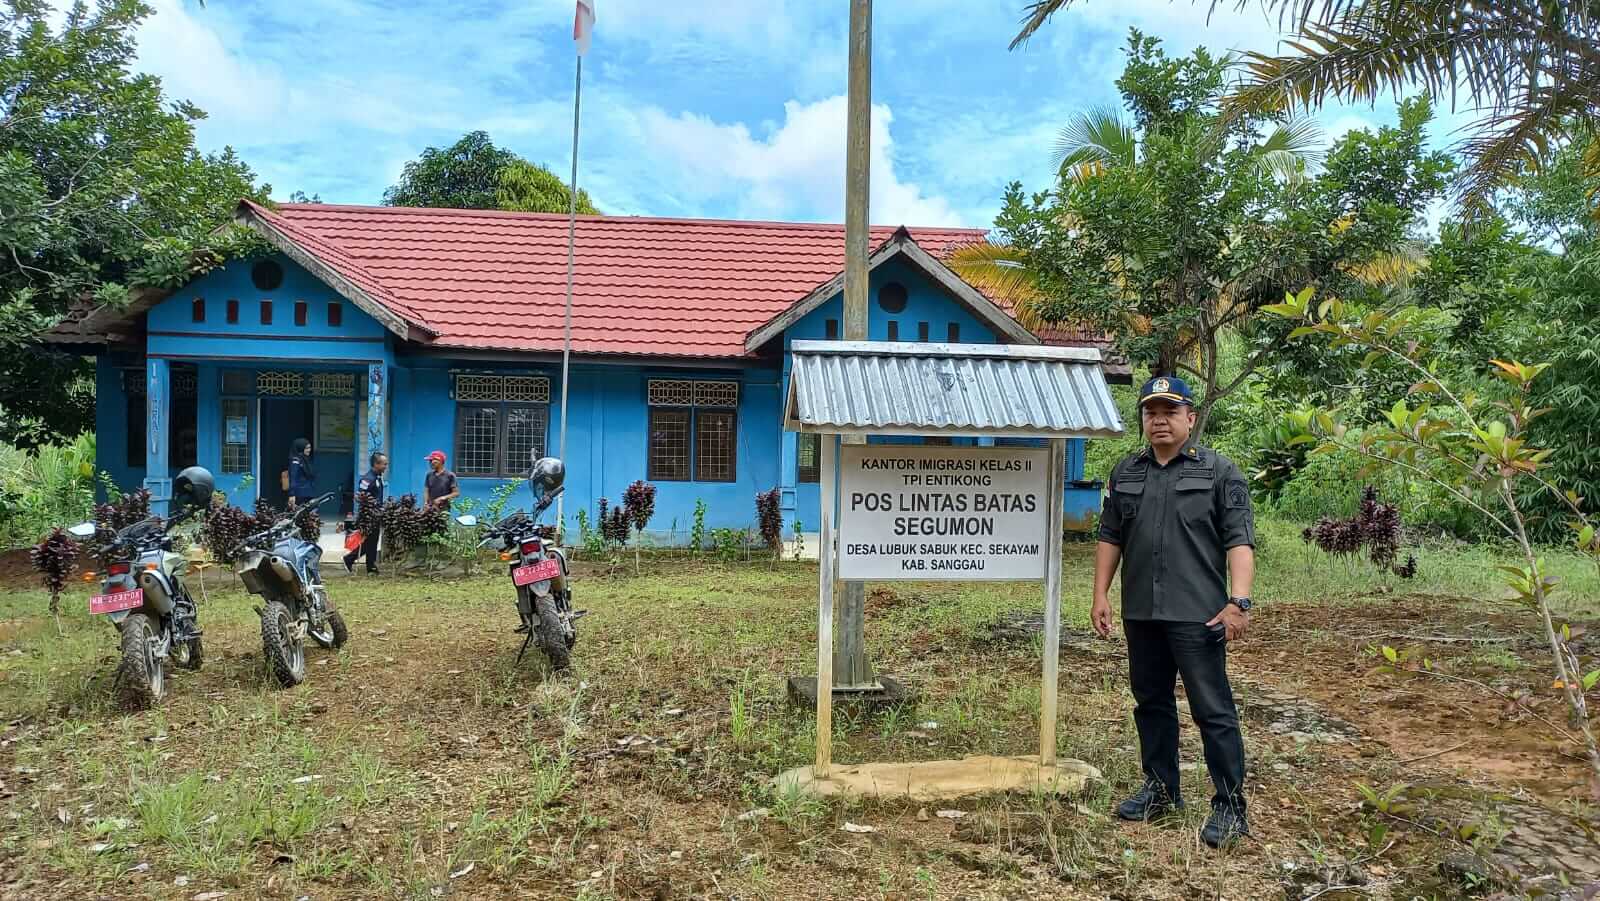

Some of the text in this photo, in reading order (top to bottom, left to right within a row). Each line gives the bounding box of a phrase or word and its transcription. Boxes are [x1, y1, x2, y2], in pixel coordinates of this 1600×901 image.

[862, 458, 1032, 471] KANTOR IMIGRASI KELAS II
[902, 475, 991, 486] TPI ENTIKONG
[852, 493, 1035, 512] POS LINTAS BATAS
[894, 517, 993, 535] SEGUMON
[847, 544, 1039, 555] DESA LUBUK SABUK KEC. SEKAYAM
[902, 559, 984, 570] KAB. SANGGAU
